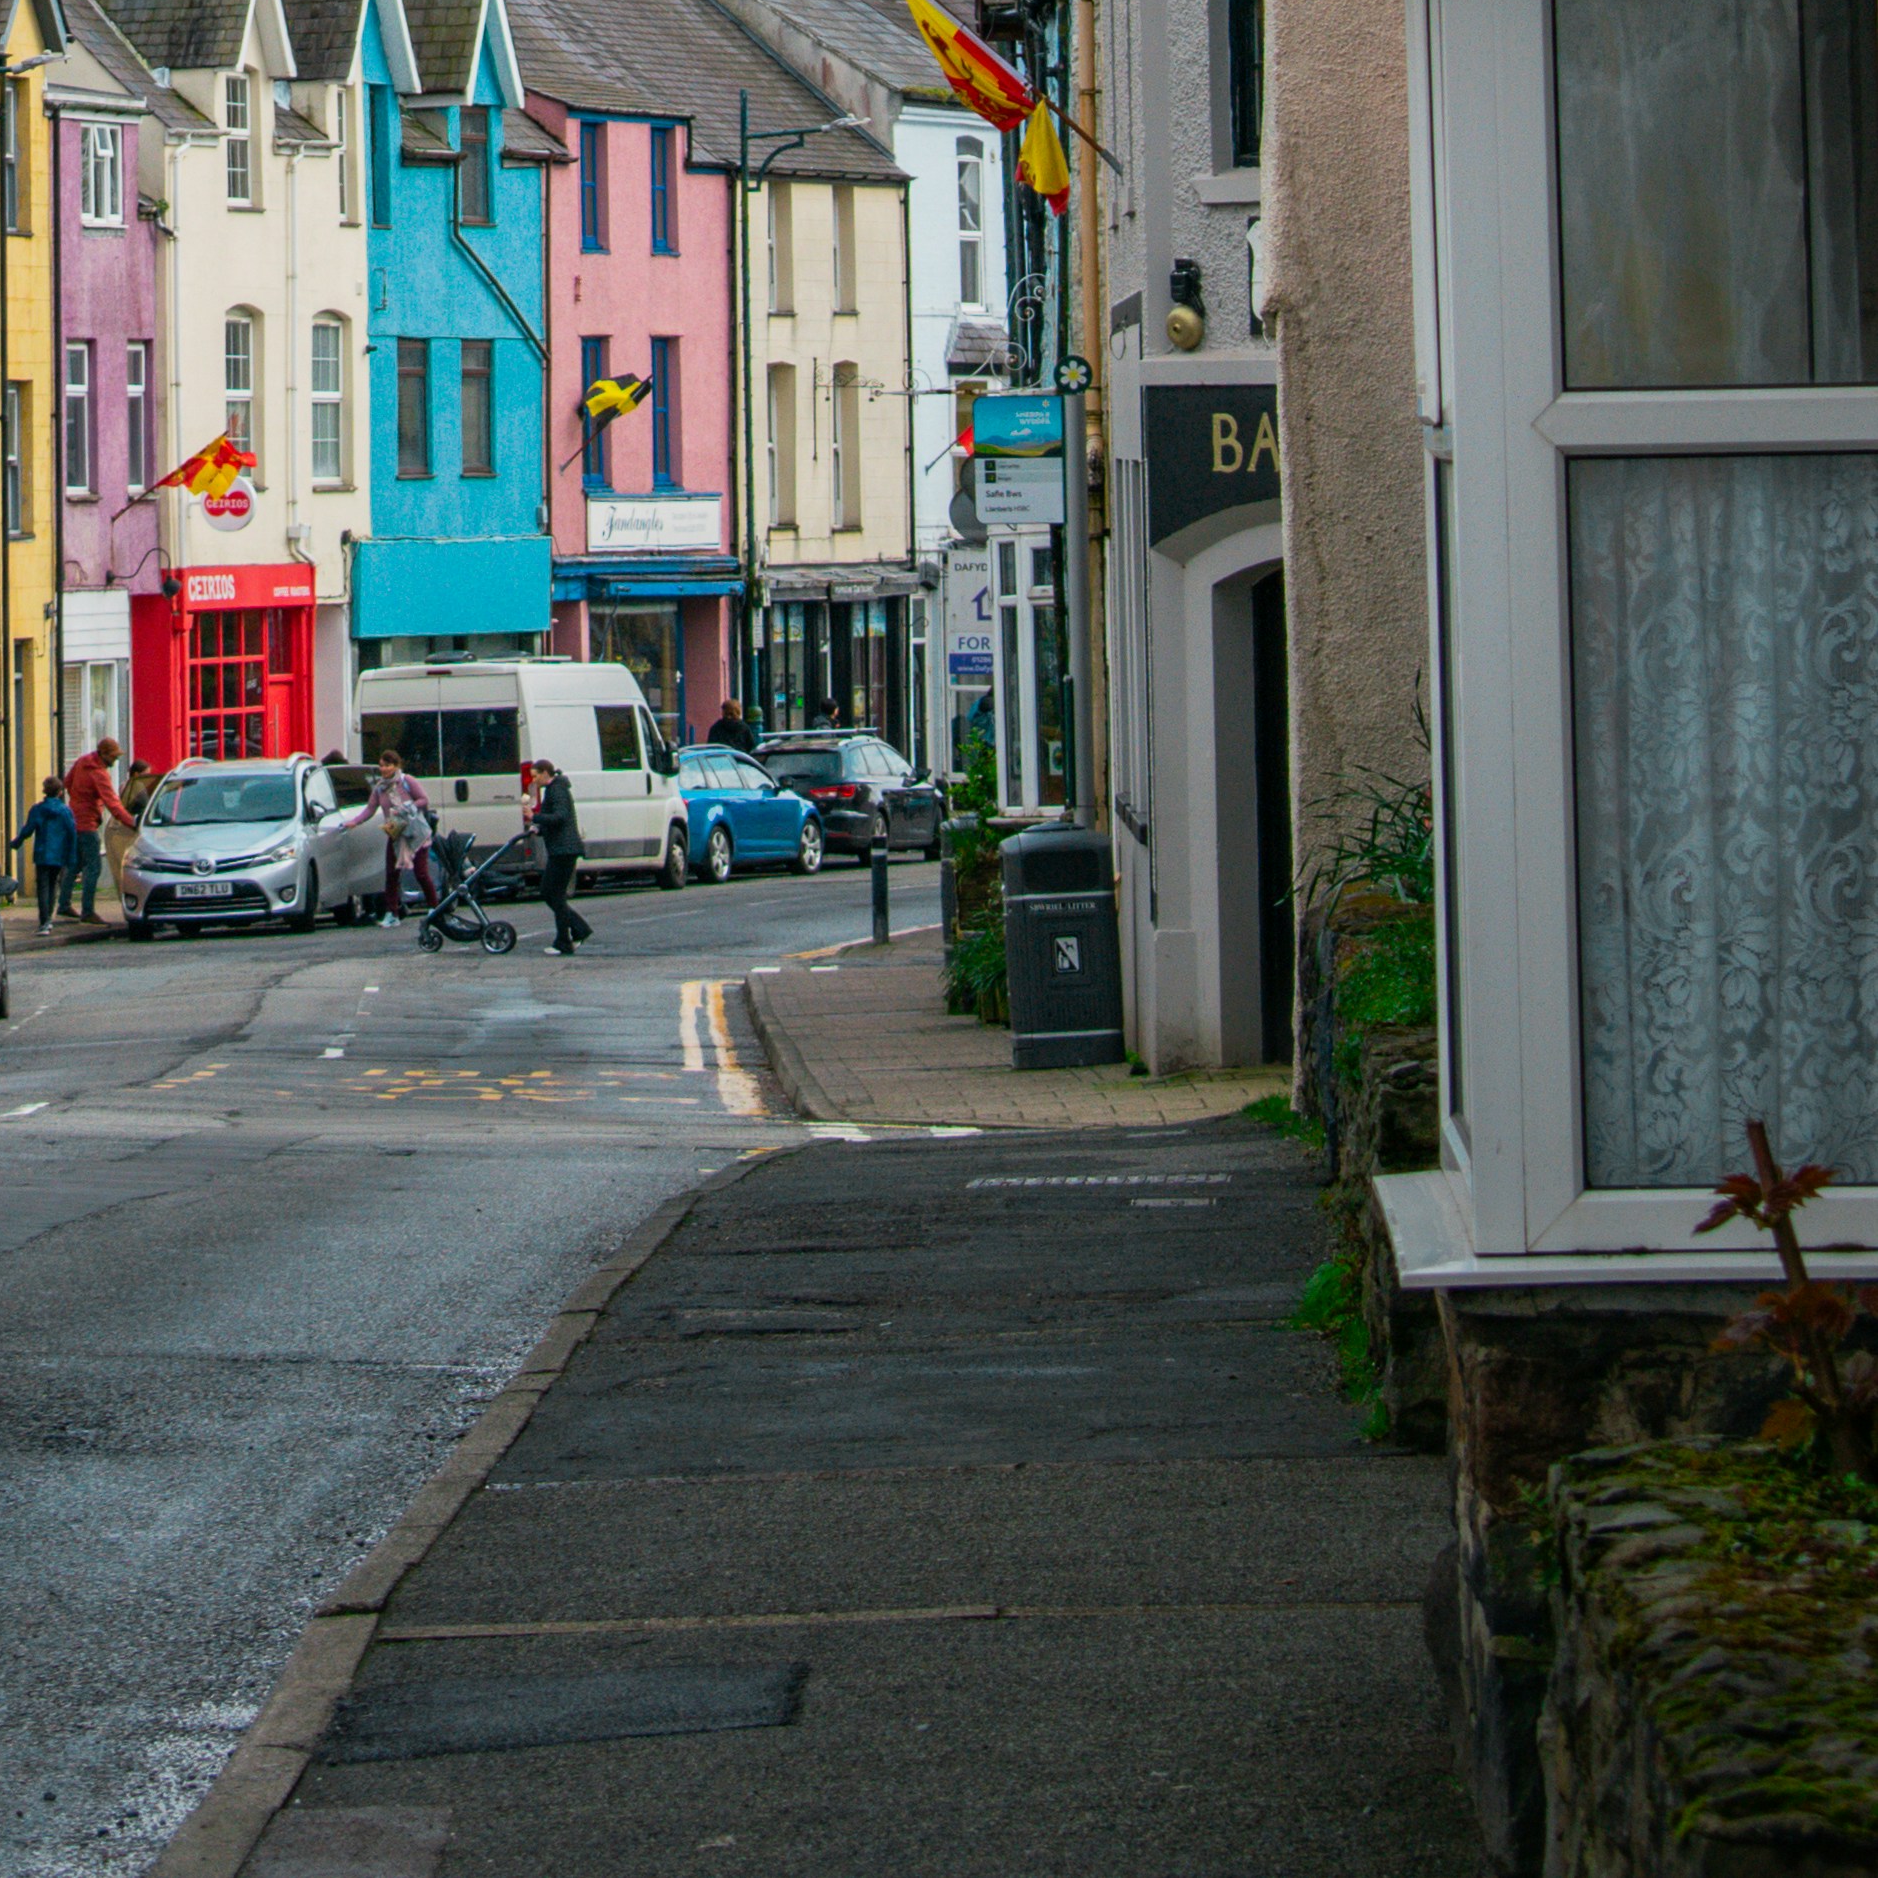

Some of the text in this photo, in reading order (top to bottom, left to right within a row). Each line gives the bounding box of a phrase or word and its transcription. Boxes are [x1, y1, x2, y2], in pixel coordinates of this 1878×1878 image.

[1212, 412, 1280, 473] BA
[188, 575, 235, 601] CEIRIOS
[958, 637, 991, 650] FOR
[210, 883, 228, 894] TLU
